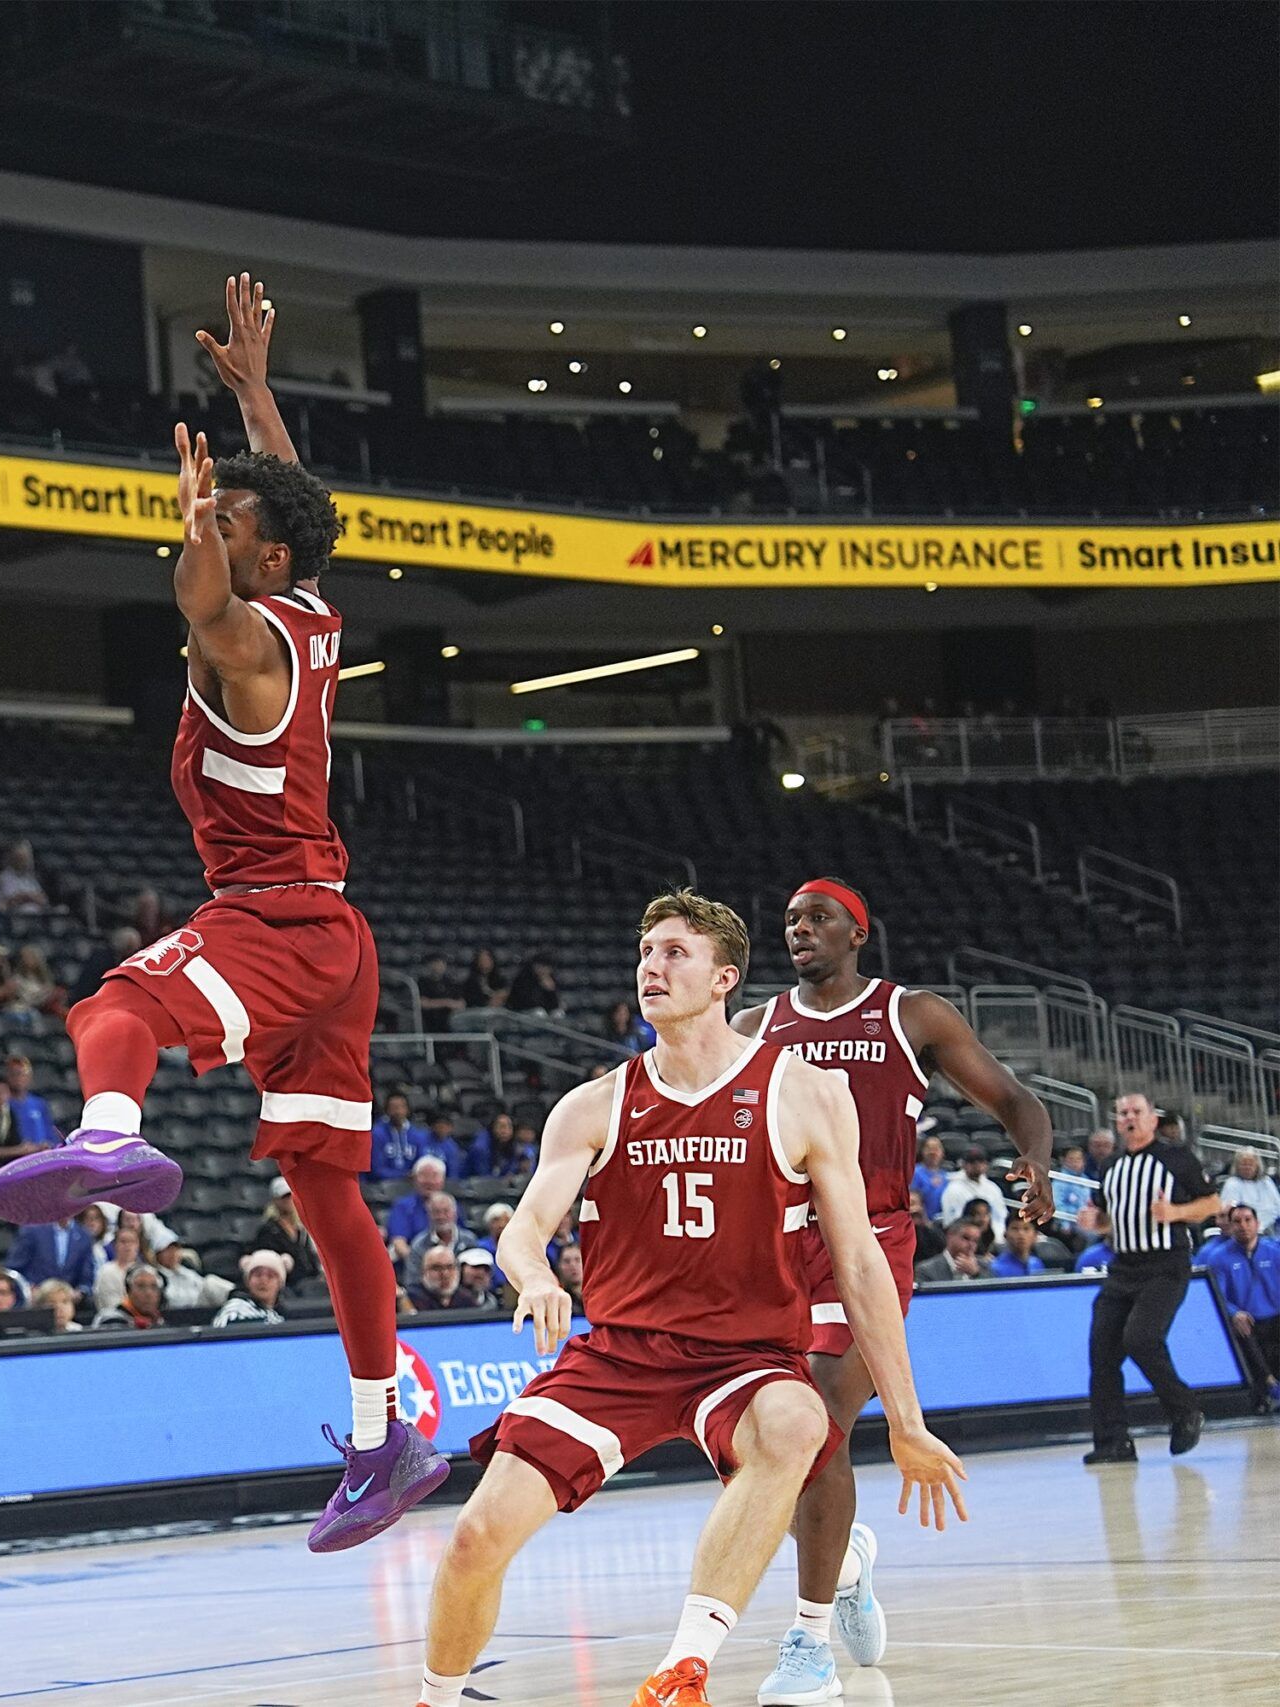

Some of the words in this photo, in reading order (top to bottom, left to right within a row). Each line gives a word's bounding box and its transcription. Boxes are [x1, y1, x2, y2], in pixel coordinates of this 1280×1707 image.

[23, 474, 130, 517] Smart
[358, 510, 452, 547] Smart
[457, 518, 555, 564] People
[658, 540, 827, 569] MERCURY
[839, 540, 1043, 569] INSURANCE
[1078, 540, 1184, 569] Smart
[1191, 538, 1280, 567] Insu
[309, 629, 341, 671] OKO
[782, 1040, 886, 1063] ANFORD
[626, 1136, 748, 1166] STANFORD
[662, 1172, 716, 1239] 15
